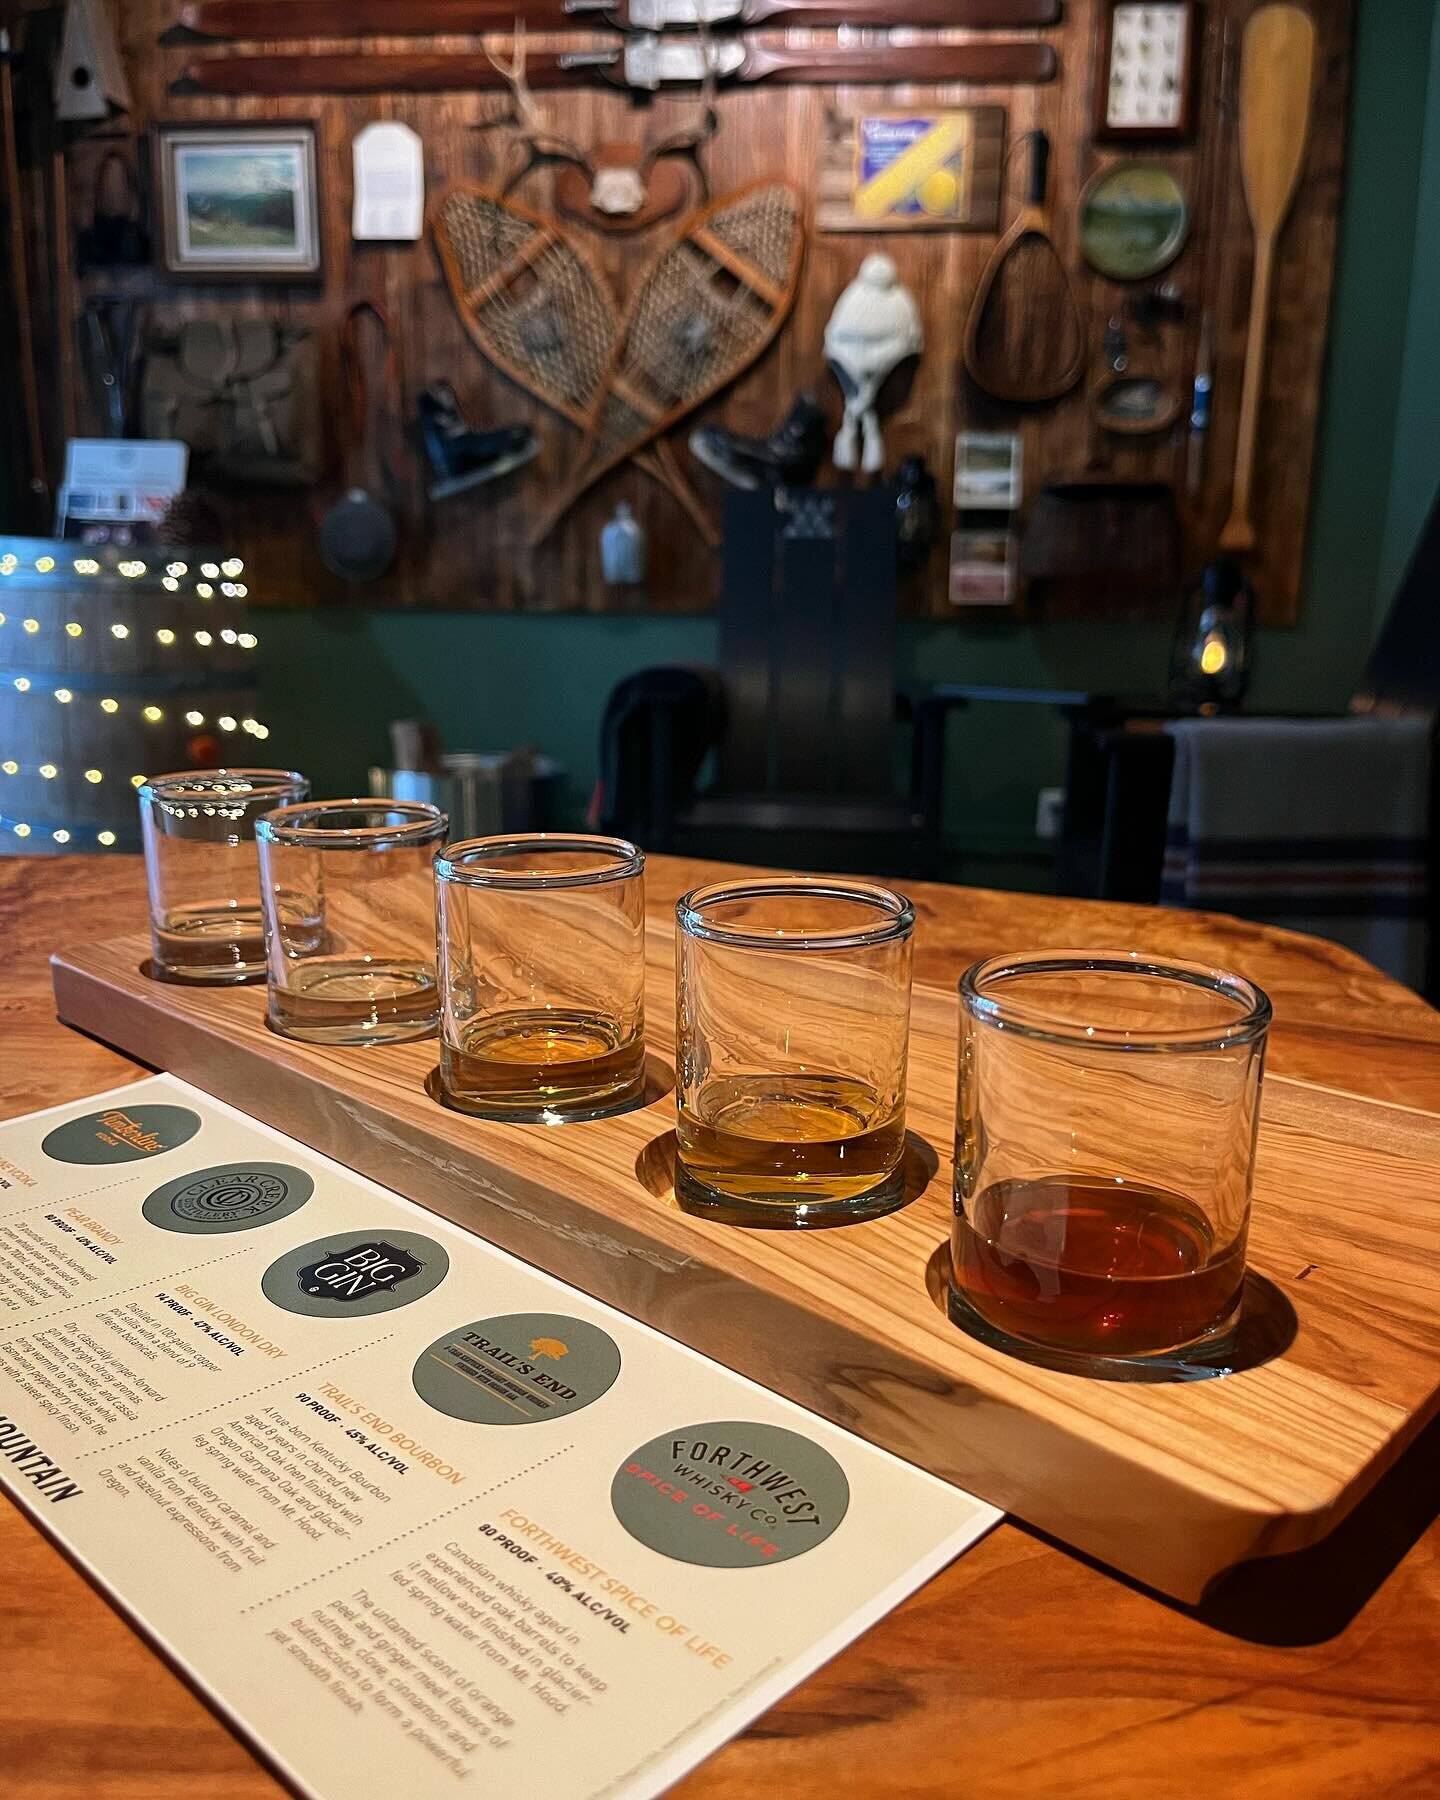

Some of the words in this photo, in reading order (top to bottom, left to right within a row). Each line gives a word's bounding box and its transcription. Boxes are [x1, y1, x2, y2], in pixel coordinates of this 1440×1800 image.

[62, 1207, 92, 1224] PEAR
[81, 1220, 125, 1246] BRANDY
[184, 1197, 240, 1218] DISTILLERY
[186, 1174, 259, 1196] CLEAR
[244, 1179, 281, 1215] CREEK
[50, 1218, 77, 1233] PROOF
[75, 1236, 93, 1247] 40%
[86, 1245, 118, 1265] ALC/VOL
[314, 1262, 377, 1296] GIN
[344, 1248, 406, 1282] BIG
[15, 1336, 37, 1354] bring
[31, 1350, 61, 1373] warmth
[63, 1321, 81, 1336] Dry,
[76, 1333, 115, 1361] classically
[104, 1357, 169, 1402] juniper-forward
[95, 1312, 127, 1335] different
[107, 1306, 127, 1318] pot
[120, 1316, 142, 1330] stills
[136, 1327, 157, 1341] with
[156, 1341, 183, 1359] blend
[125, 1302, 158, 1324] Distilled
[158, 1326, 197, 1356] 100-gallon
[193, 1353, 223, 1373] copper
[154, 1292, 170, 1302] 94
[162, 1298, 193, 1316] PROOF
[193, 1320, 214, 1334] 47%
[207, 1331, 245, 1357] ALC/VOL
[173, 1284, 200, 1299] BIG
[192, 1296, 219, 1313] GIN
[210, 1309, 265, 1344] LONDON
[255, 1341, 289, 1360] DRY
[2, 1341, 36, 1372] Tasmanian
[26, 1370, 74, 1406] pepperberry
[67, 1403, 96, 1426] tickles
[90, 1423, 108, 1436] the
[3, 1366, 21, 1379] with
[20, 1382, 47, 1401] sweet
[38, 1399, 62, 1416] spicy
[31, 1332, 70, 1364] Cardamom,
[98, 1389, 121, 1402] and
[111, 1400, 139, 1421] cassia
[44, 1327, 63, 1338] gin
[57, 1335, 78, 1349] with
[70, 1345, 97, 1365] bright
[90, 1363, 118, 1383] citrusy
[112, 1381, 144, 1406] aromas.
[61, 1377, 78, 1389] the
[69, 1387, 99, 1407] palate
[462, 1331, 535, 1375] TRAIL'S
[531, 1372, 577, 1400] END
[93, 1404, 118, 1424] while
[294, 1392, 312, 1403] 90
[305, 1400, 342, 1423] PROOF
[344, 1428, 369, 1445] 45%
[363, 1443, 410, 1476] ALC/VOL
[317, 1381, 367, 1415] TRAIL'S
[359, 1411, 395, 1435] END
[387, 1432, 467, 1486] BOURBON
[0, 1415, 84, 1503] OUNTAIN
[97, 1468, 131, 1499] Oregon.
[204, 1445, 236, 1470] spring
[231, 1466, 262, 1489] water
[255, 1485, 281, 1506] from
[293, 1515, 326, 1542] Hood.
[207, 1426, 243, 1453] Oregon
[239, 1449, 281, 1483] Garryana
[277, 1480, 301, 1498] Oak
[295, 1495, 321, 1512] and
[309, 1510, 352, 1541] glacier-
[226, 1420, 269, 1453] American
[265, 1449, 288, 1467] Oak
[282, 1463, 307, 1482] then
[303, 1478, 347, 1510] finished
[339, 1507, 364, 1526] with
[244, 1413, 272, 1431] aged
[267, 1433, 299, 1454] years
[303, 1459, 346, 1488] charred
[338, 1485, 363, 1503] new
[268, 1411, 312, 1443] true-born
[307, 1440, 353, 1474] Kentucky
[348, 1470, 392, 1504] Bourbon
[672, 1440, 821, 1526] FORTHWEST
[674, 1463, 751, 1510] WHISKY
[117, 1462, 141, 1477] and
[131, 1474, 174, 1508] hazelnut
[165, 1506, 221, 1553] expressions
[215, 1549, 243, 1573] from
[136, 1455, 166, 1479] vanilla
[160, 1476, 186, 1497] from
[181, 1494, 225, 1531] Kentucky
[219, 1528, 245, 1549] with
[239, 1545, 267, 1566] fruit
[154, 1447, 183, 1471] Notes
[187, 1474, 223, 1504] buttery
[216, 1502, 260, 1535] caramel
[252, 1532, 280, 1550] and
[625, 1463, 688, 1504] SPICE
[691, 1502, 726, 1521] OF
[725, 1523, 782, 1558] LIFE
[388, 1569, 414, 1588] fed
[407, 1585, 447, 1619] spring
[442, 1613, 481, 1642] water
[475, 1639, 510, 1667] from
[444, 1541, 497, 1583] Canadian
[494, 1579, 538, 1613] whisky
[533, 1609, 571, 1635] aged
[477, 1523, 498, 1537] 80
[492, 1534, 539, 1563] PROOF
[545, 1571, 575, 1594] 40%
[570, 1591, 631, 1635] ALC/VOL
[498, 1508, 608, 1581] FORTHWEST
[598, 1577, 660, 1620] SPICE
[654, 1615, 690, 1638] OF
[682, 1634, 734, 1671] LIFE
[415, 1568, 461, 1601] mellow
[456, 1600, 486, 1621] and
[479, 1616, 534, 1658] finished
[537, 1666, 593, 1707] glacier-
[425, 1552, 497, 1605] experienced
[490, 1601, 517, 1622] oak
[511, 1617, 562, 1657] barrels
[572, 1663, 608, 1695] keep
